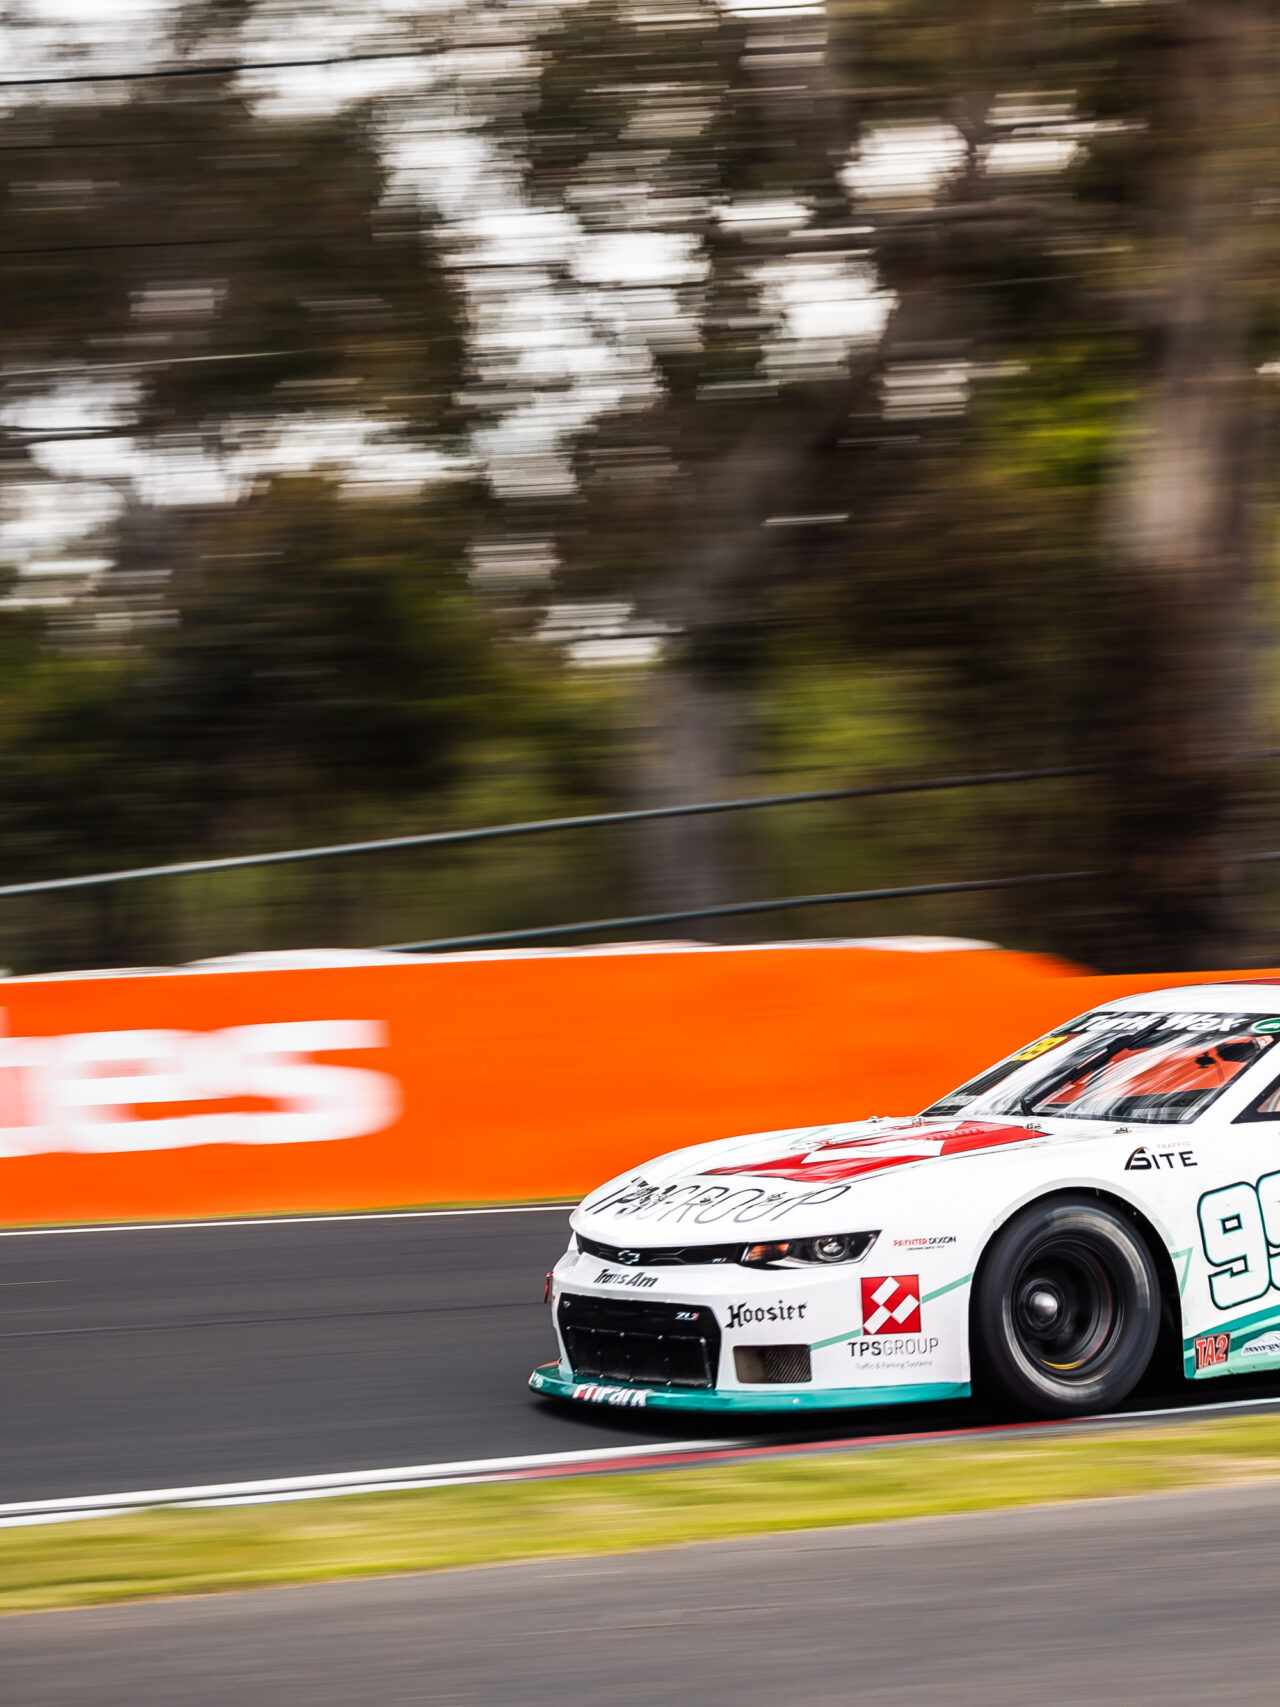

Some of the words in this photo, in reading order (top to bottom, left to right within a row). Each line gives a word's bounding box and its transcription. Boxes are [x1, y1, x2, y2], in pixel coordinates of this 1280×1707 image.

[593, 1268, 626, 1285] Trans
[626, 1271, 658, 1288] Am
[724, 1299, 808, 1330] Hoosier
[847, 1338, 939, 1357] TPSGROUP
[1196, 1334, 1228, 1369] TA2
